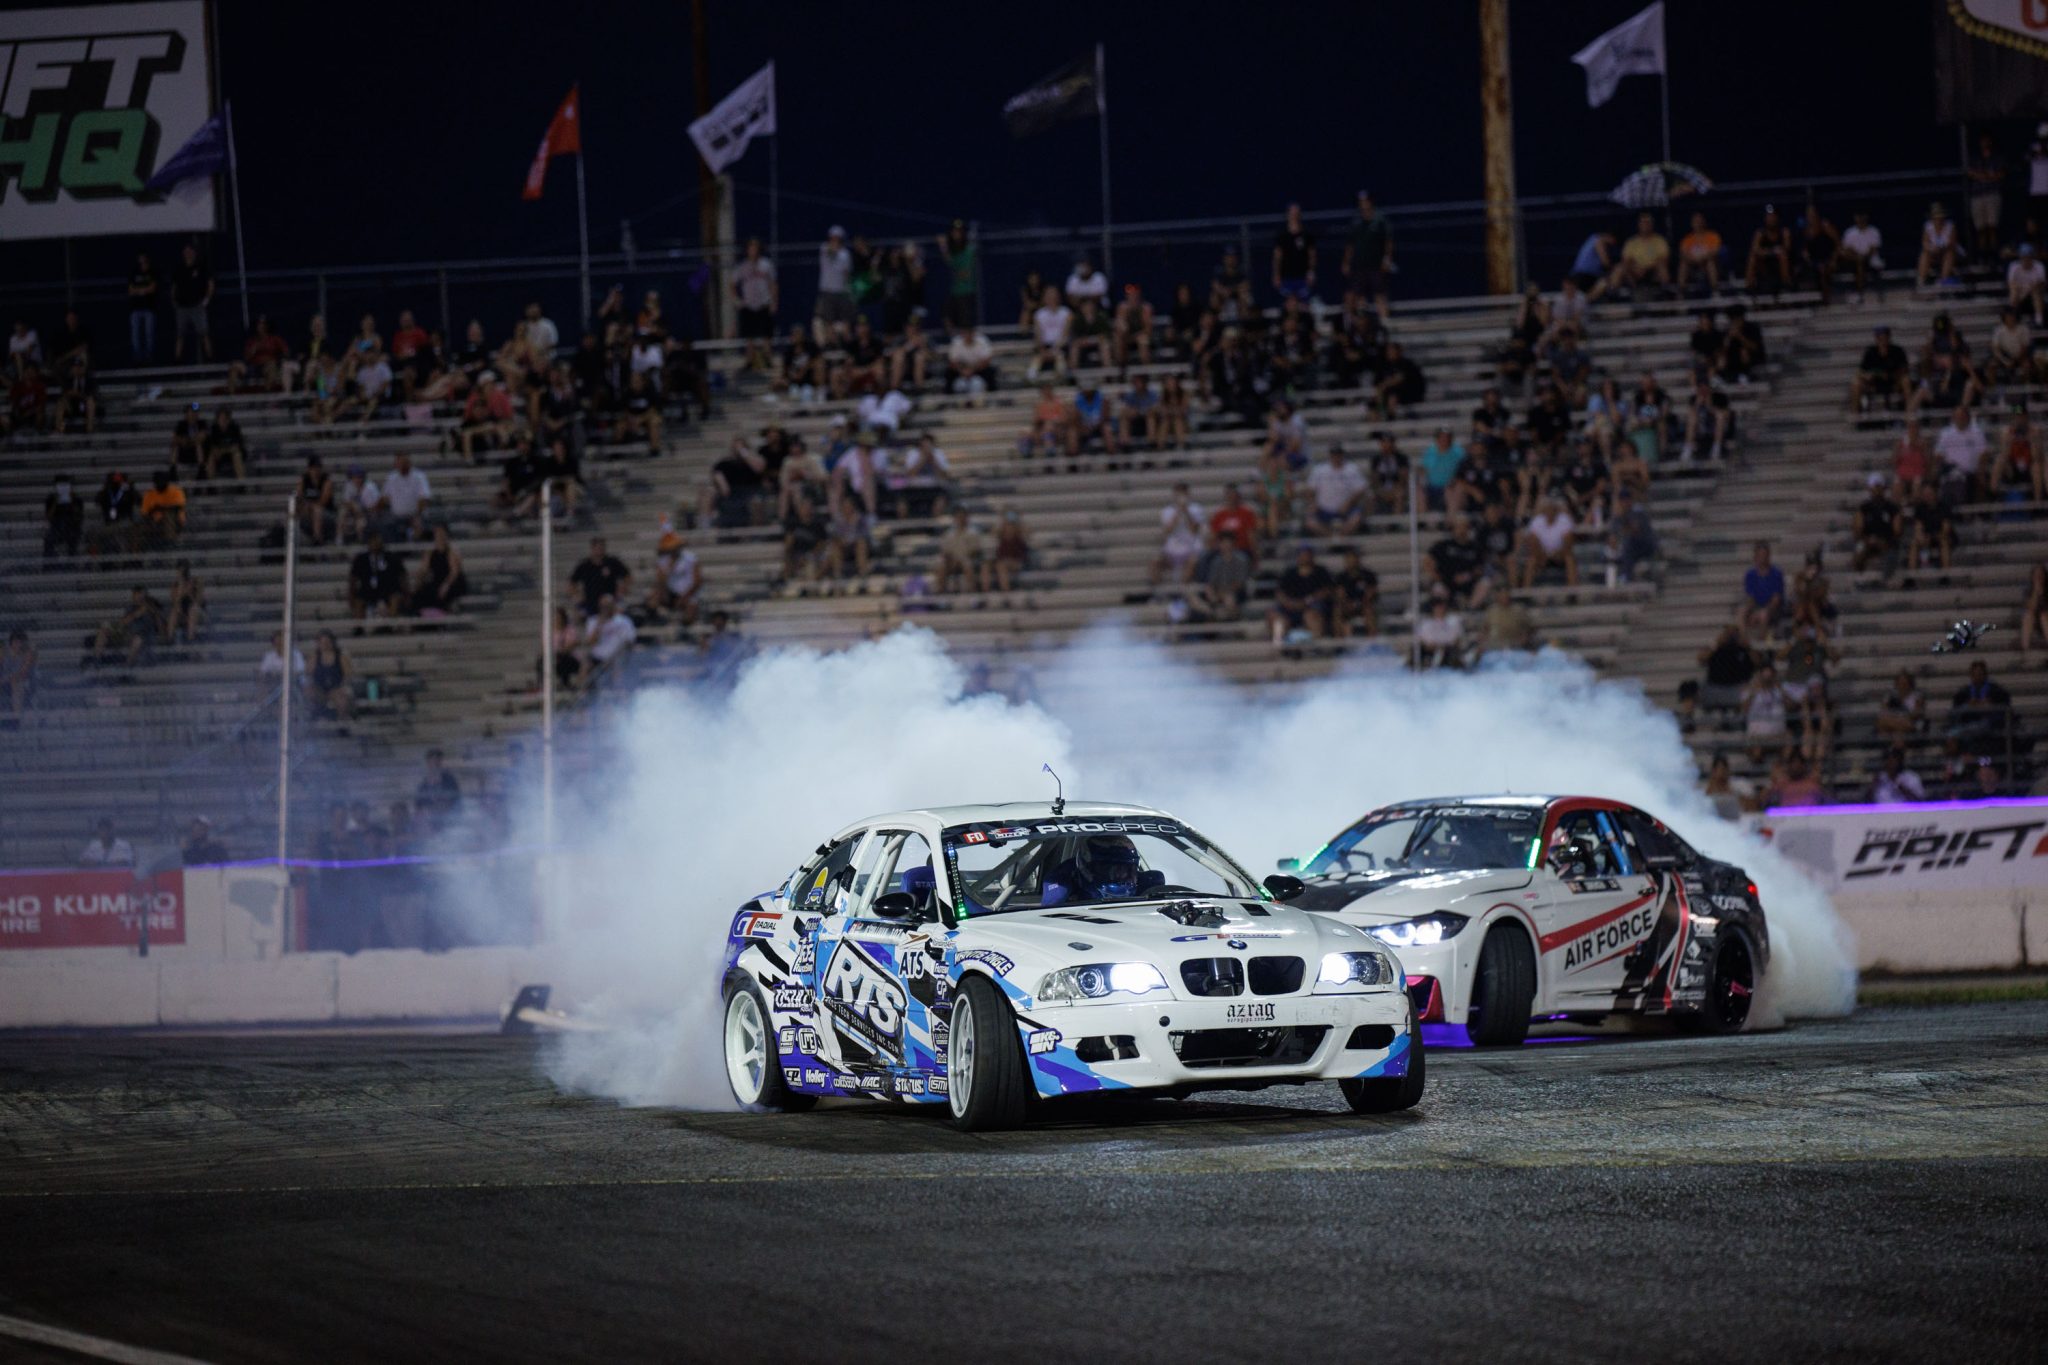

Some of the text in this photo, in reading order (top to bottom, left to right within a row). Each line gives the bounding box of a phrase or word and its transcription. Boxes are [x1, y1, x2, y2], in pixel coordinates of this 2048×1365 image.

[966, 831, 985, 843] FD
[1036, 824, 1178, 835] PROSPEC
[54, 892, 177, 916] KUMHO
[117, 914, 176, 931] TIRE
[733, 911, 783, 937] GT RADIAL
[1565, 908, 1653, 970] AIR FORCE
[899, 952, 923, 976] ATS
[826, 942, 906, 1034] RTS
[1227, 1003, 1276, 1021] azrag
[806, 1069, 826, 1087] Holley
